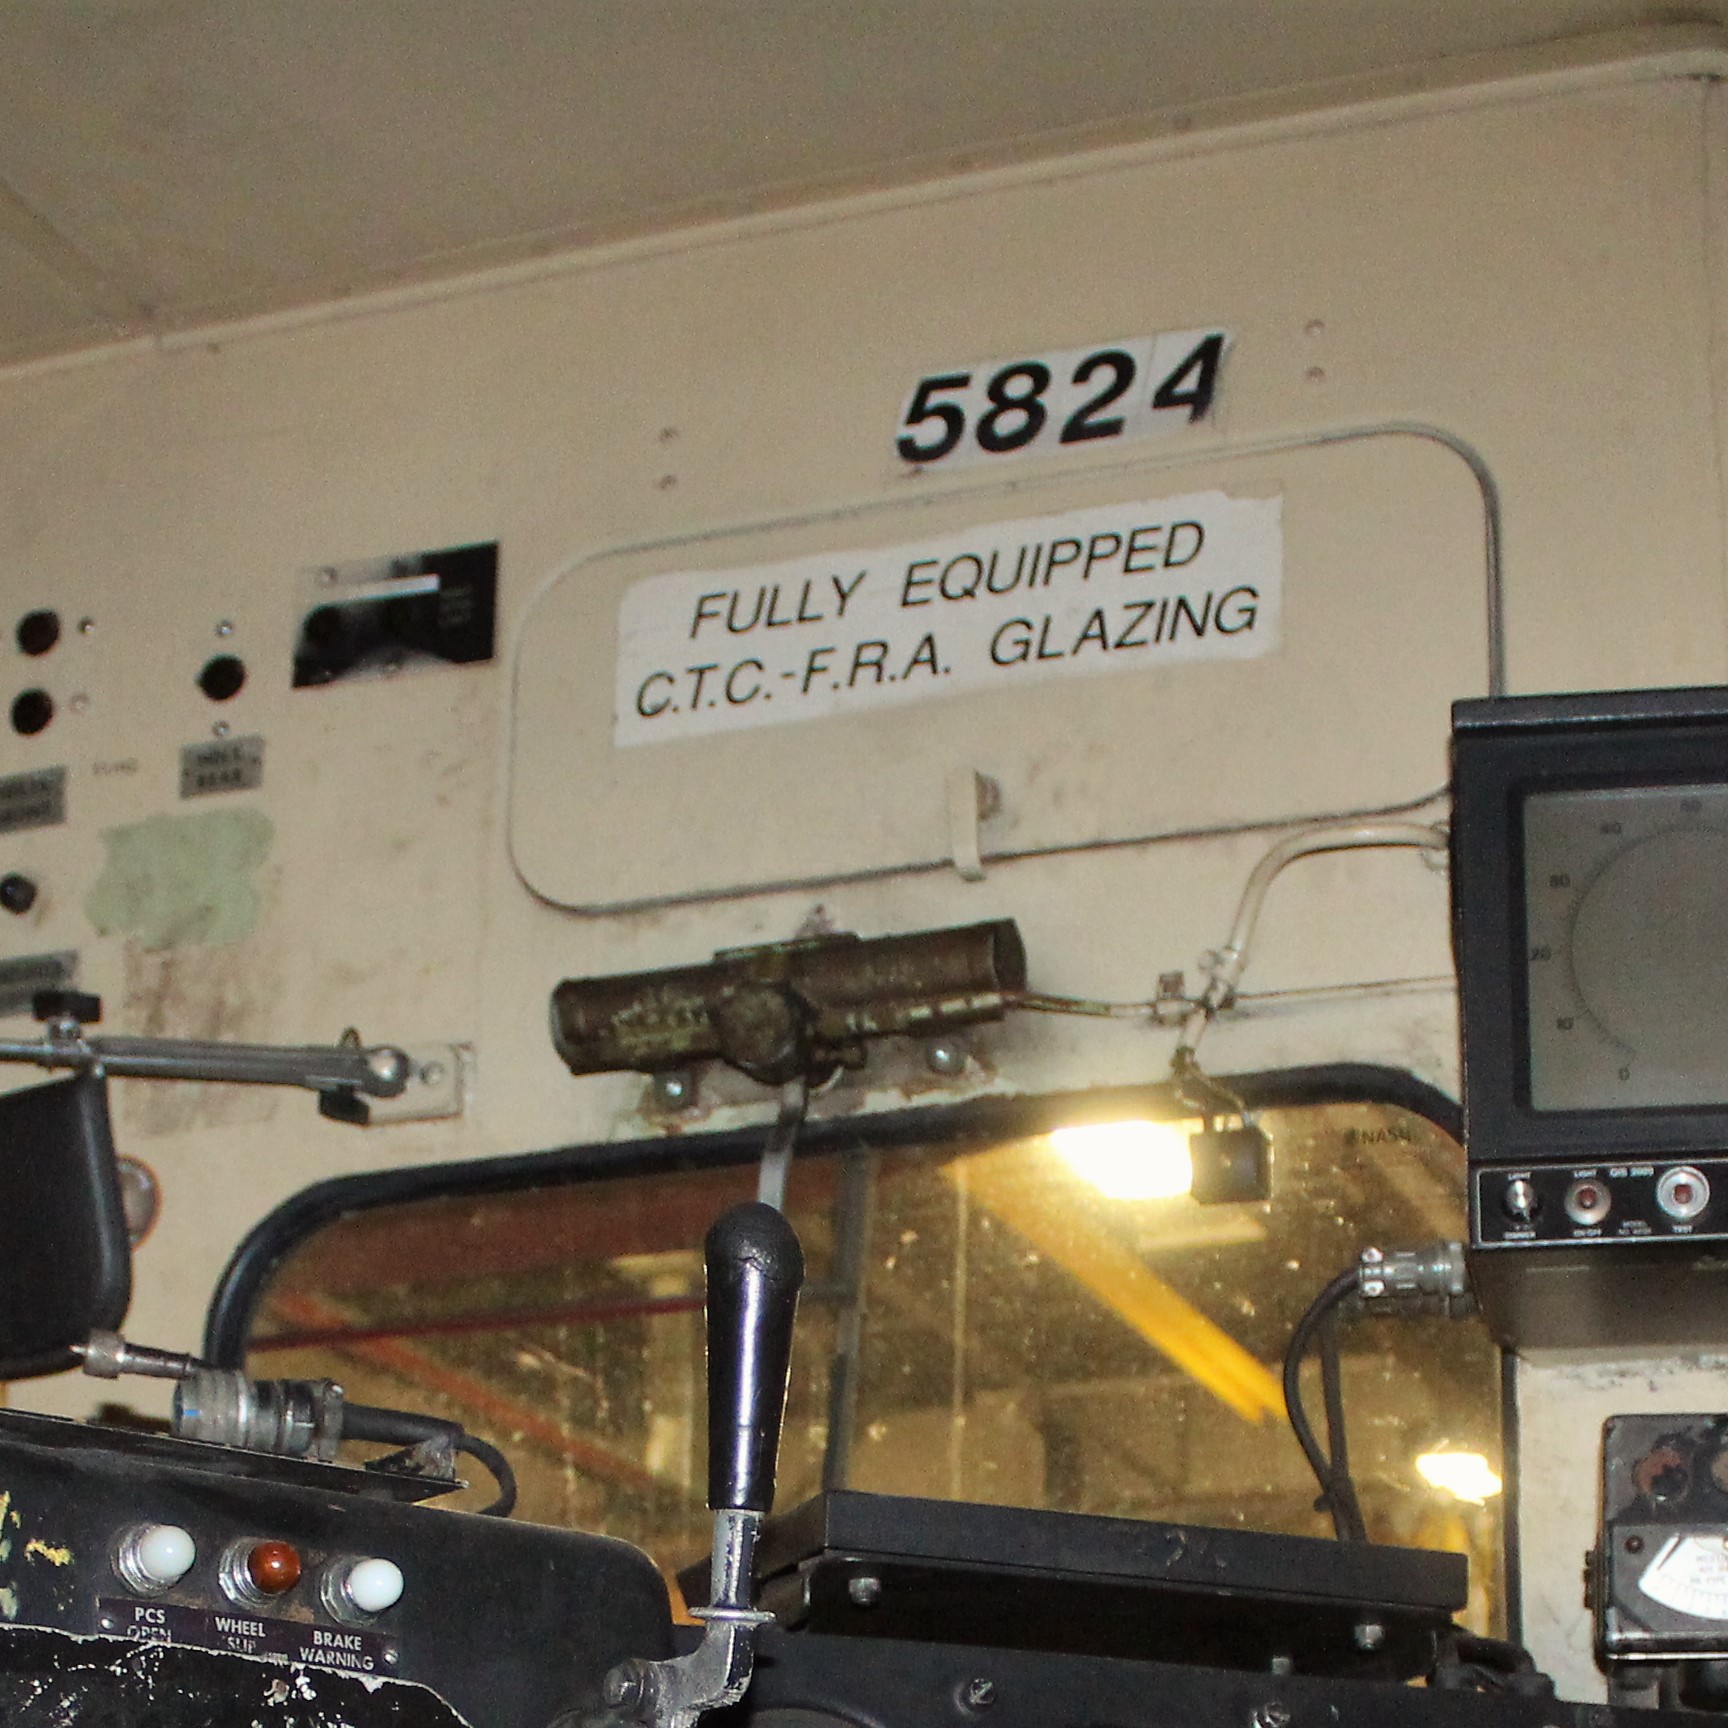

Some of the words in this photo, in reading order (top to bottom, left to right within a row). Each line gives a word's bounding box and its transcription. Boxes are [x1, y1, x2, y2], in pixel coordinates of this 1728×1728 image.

[896, 333, 1225, 462] 5824
[688, 570, 867, 638] FULLY
[900, 521, 1205, 608] EQUIPPED
[634, 634, 951, 718] C.T.C.-F.R.A.
[989, 585, 1261, 666] GLAZING
[135, 1607, 166, 1624] PCS
[215, 1617, 266, 1638] WHEEL
[313, 1631, 362, 1650] BRAKE
[299, 1647, 374, 1670] WARNING
